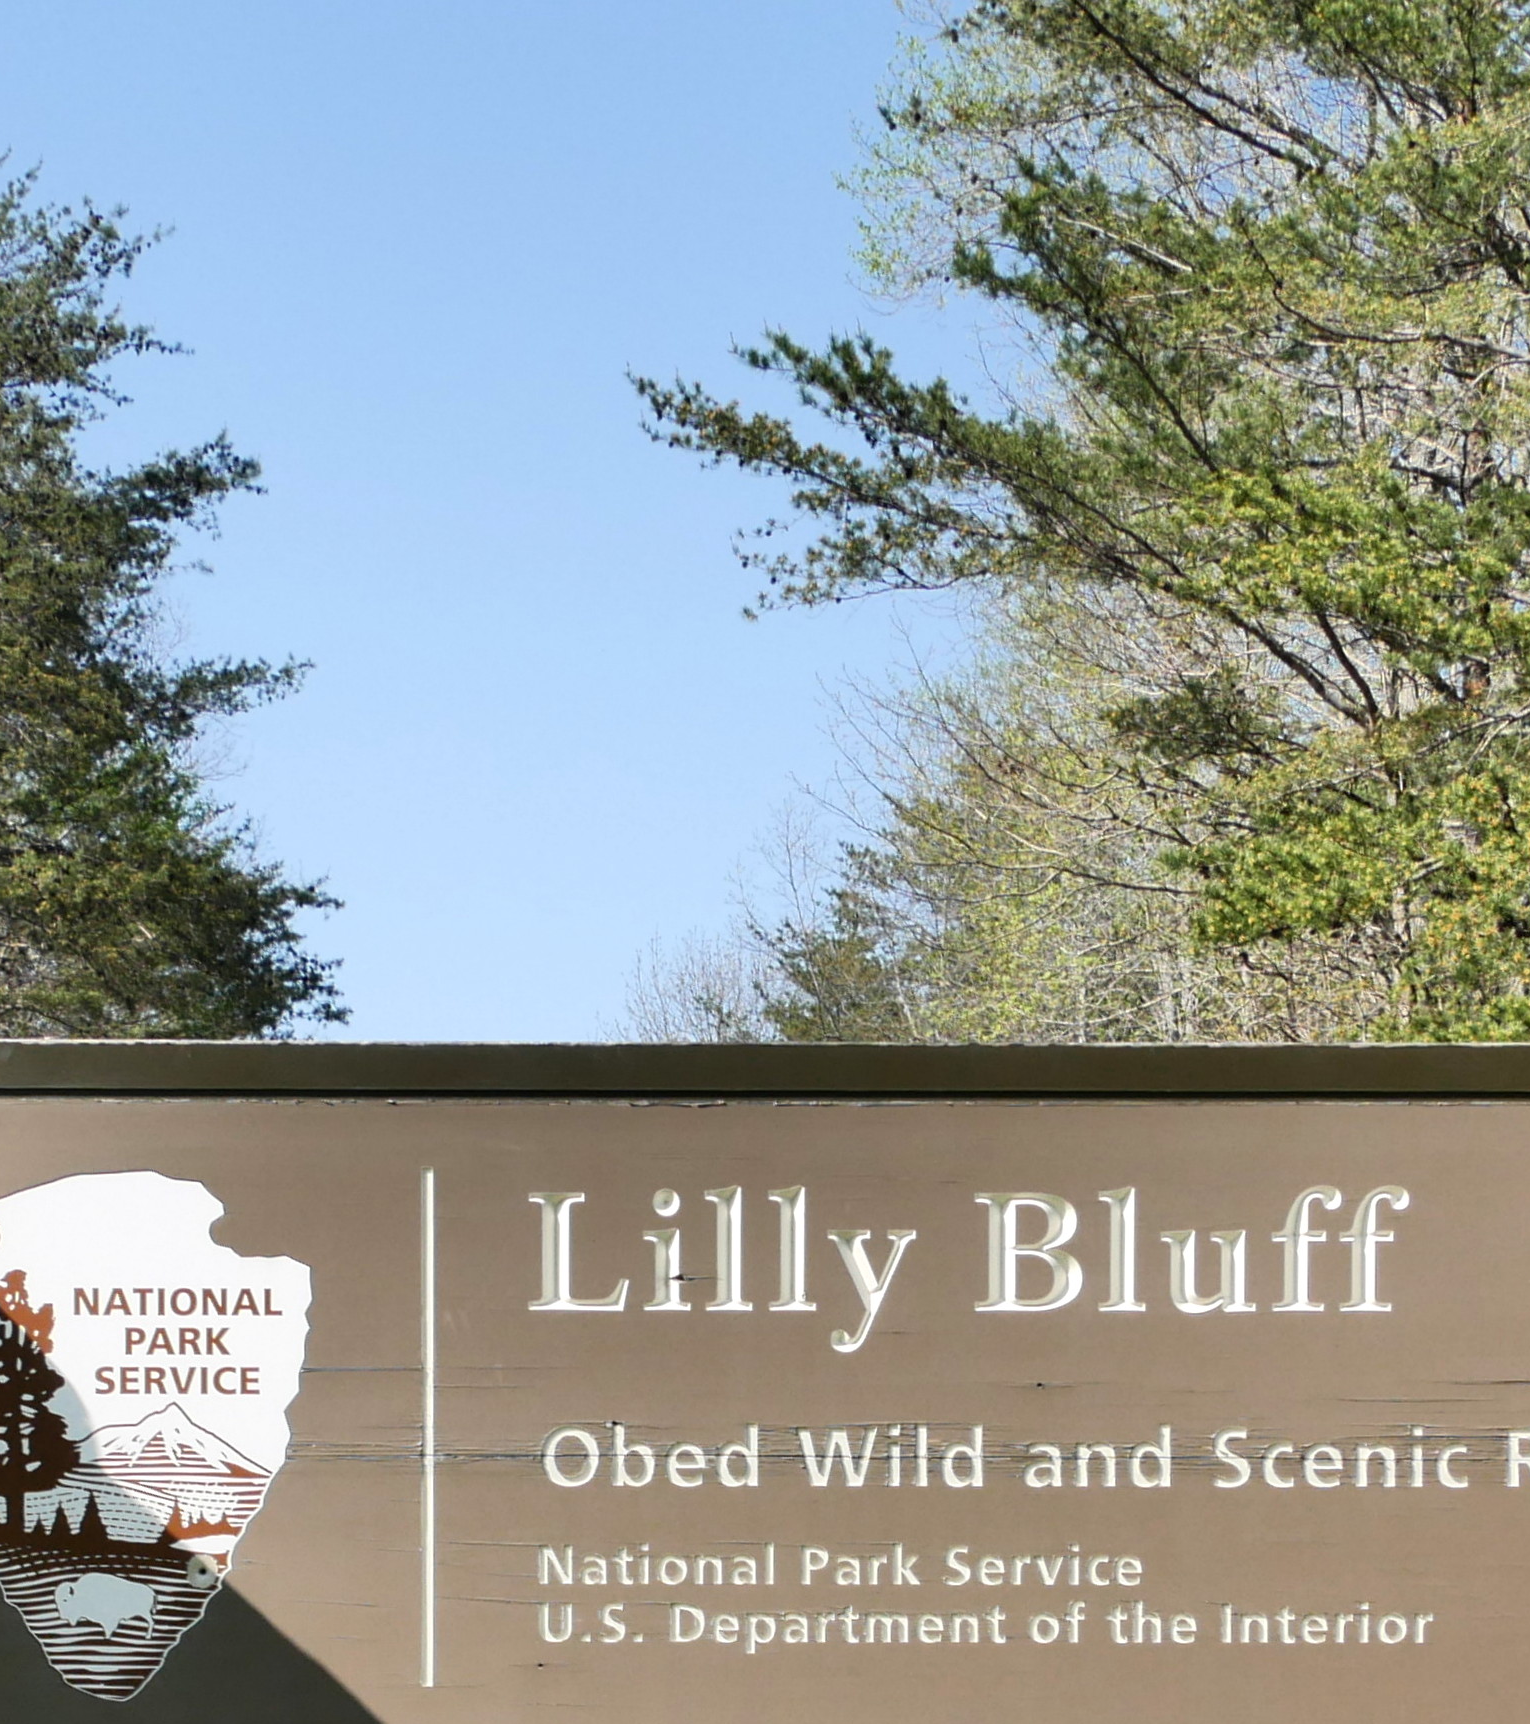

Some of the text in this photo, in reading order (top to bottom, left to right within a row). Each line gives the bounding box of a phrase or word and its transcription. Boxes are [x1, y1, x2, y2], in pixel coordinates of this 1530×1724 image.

[528, 1185, 1411, 1354] Lilly Bluff
[73, 1287, 283, 1316] NATIONAL
[125, 1327, 230, 1356] PARK
[95, 1366, 260, 1395] SERVICE
[542, 1422, 760, 1488] Obed
[798, 1423, 984, 1488] Wild
[1024, 1425, 1172, 1488] and
[1212, 1424, 1469, 1489] Scenic
[537, 1543, 1143, 1587] National Park Service
[538, 1600, 1435, 1655] U.S. Department of the Interior
